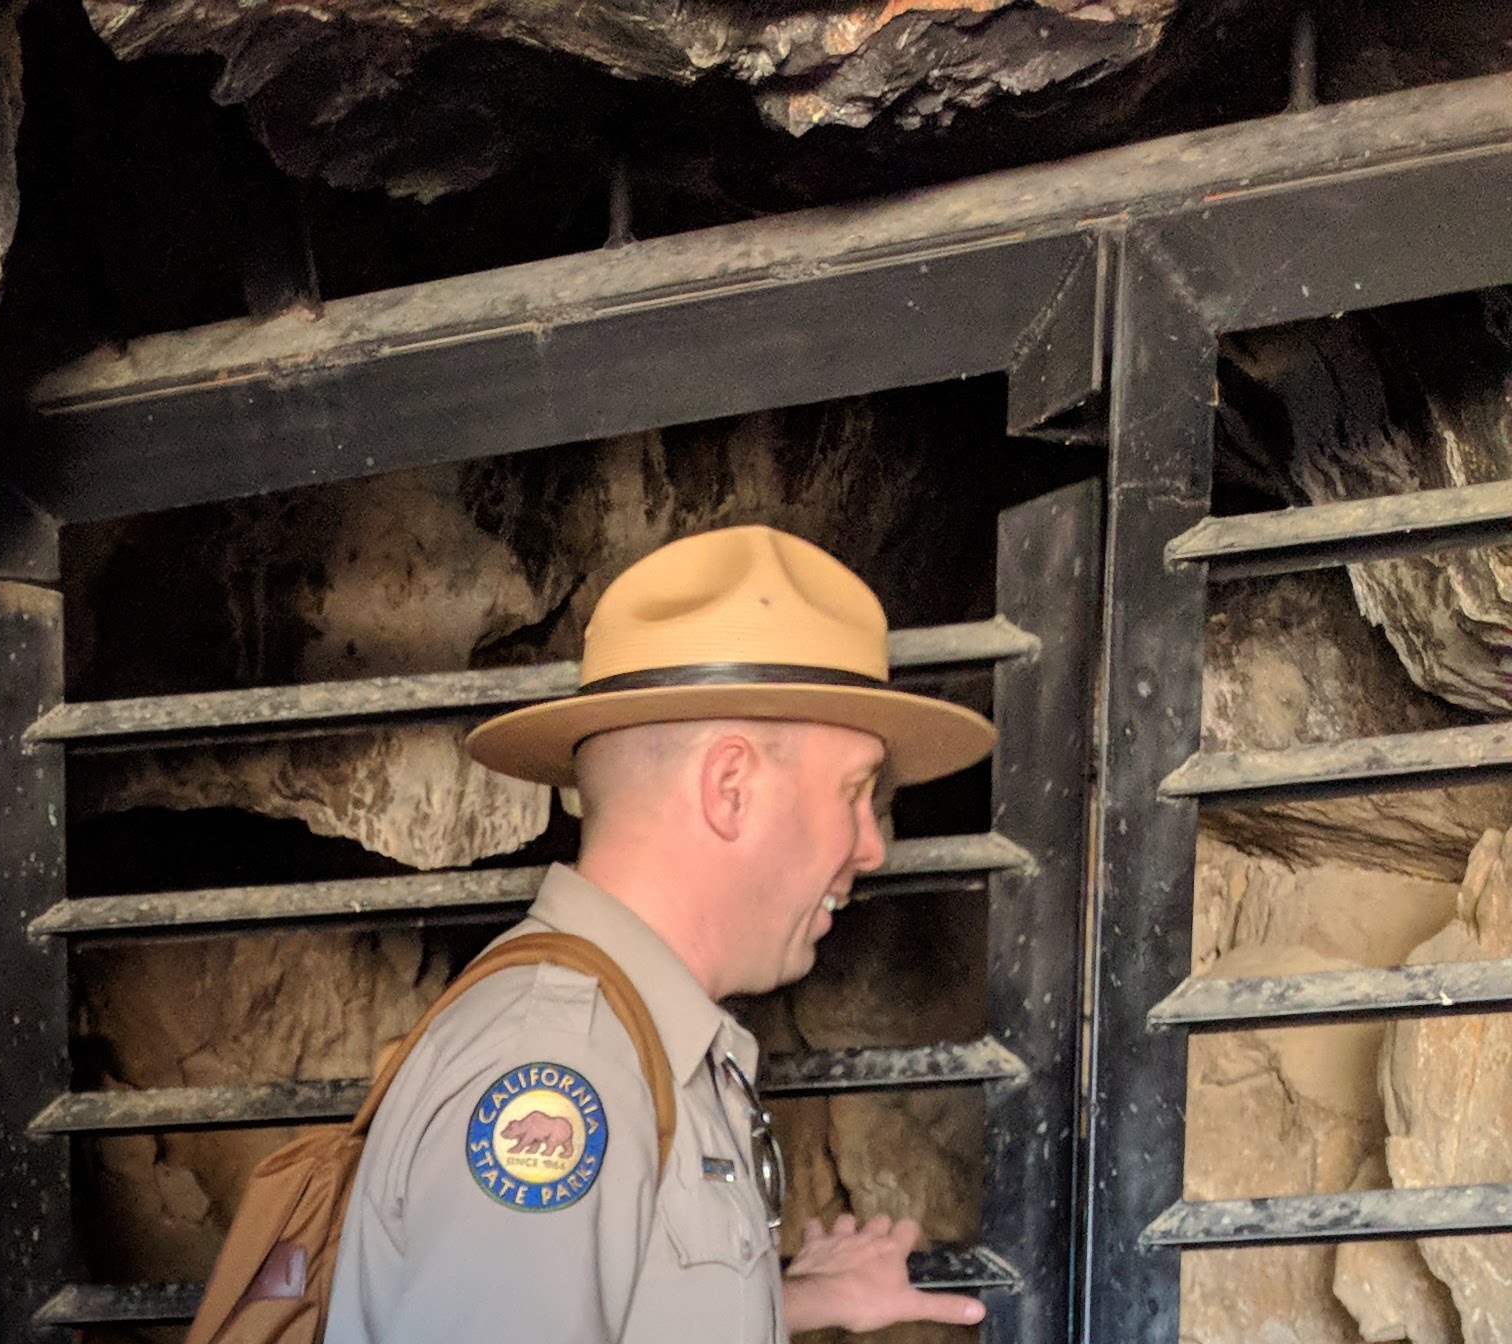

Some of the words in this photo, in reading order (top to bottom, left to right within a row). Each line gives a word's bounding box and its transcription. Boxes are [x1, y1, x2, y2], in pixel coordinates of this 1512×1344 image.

[478, 1067, 600, 1135] CALIFORNIA
[471, 1139, 529, 1205] STATE
[541, 1155, 597, 1206] PARKS
